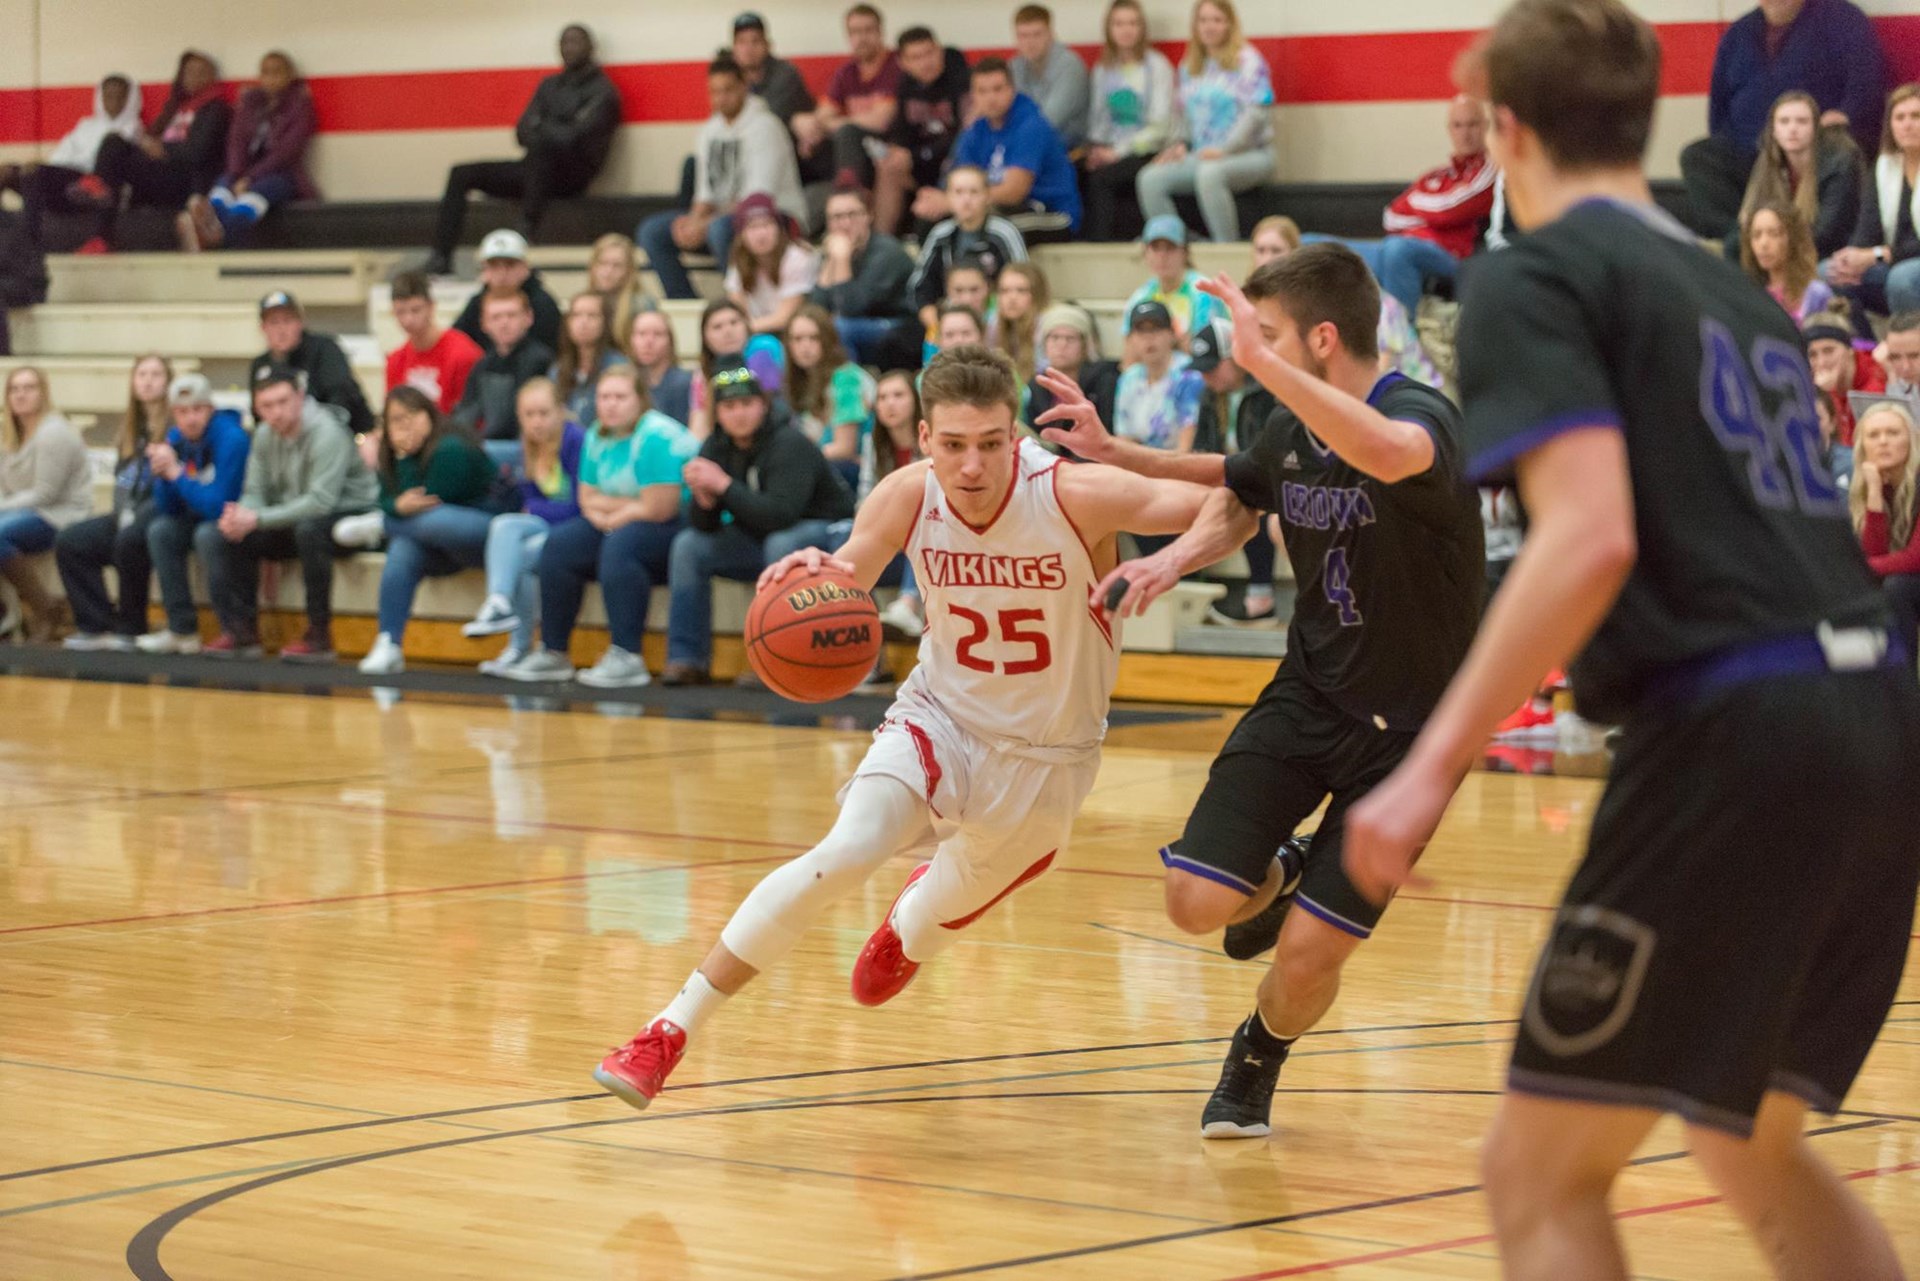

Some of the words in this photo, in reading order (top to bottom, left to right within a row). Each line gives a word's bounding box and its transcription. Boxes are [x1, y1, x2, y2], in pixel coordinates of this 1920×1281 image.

[1699, 316, 1847, 516] 42
[787, 581, 871, 613] Wilson
[921, 548, 1067, 590] VIKINGS
[1323, 547, 1363, 626] 4
[811, 624, 870, 649] NCAA
[948, 603, 1052, 675] 25
